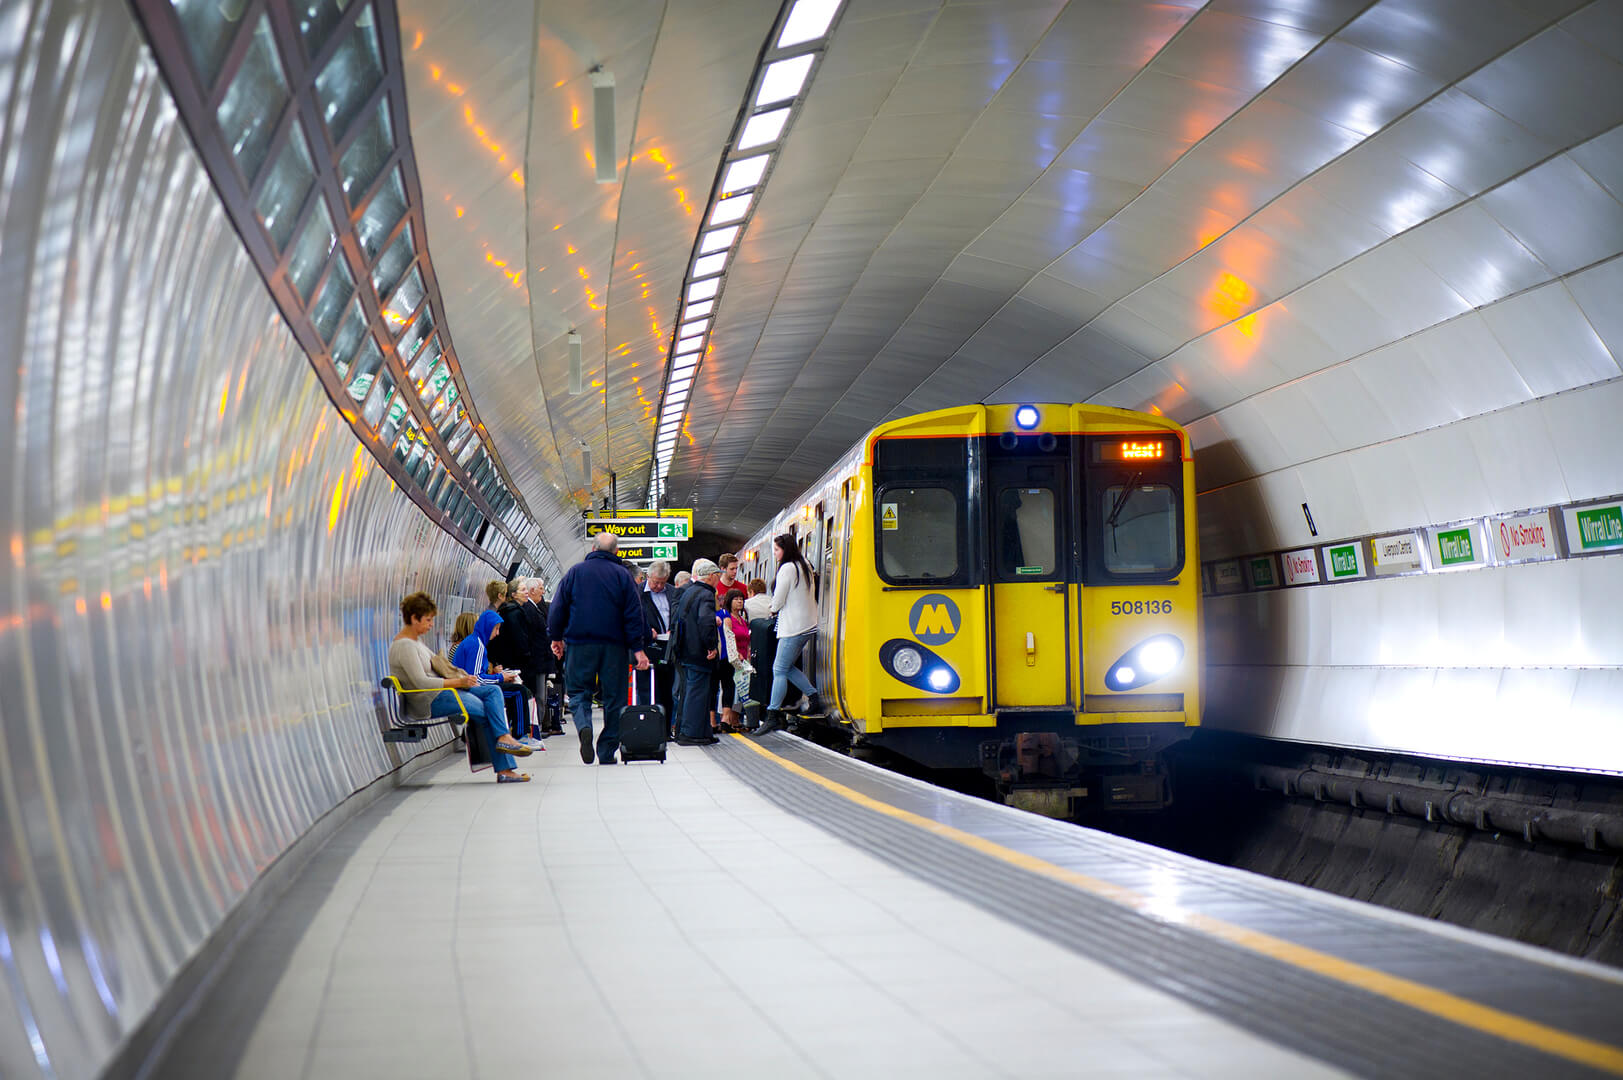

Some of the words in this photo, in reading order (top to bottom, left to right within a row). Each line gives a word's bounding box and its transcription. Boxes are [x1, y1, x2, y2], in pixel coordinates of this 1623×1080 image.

[604, 524, 626, 536] Way
[628, 525, 646, 535] out
[1509, 525, 1520, 547] No
[1519, 521, 1546, 548] Smoking
[1580, 514, 1607, 543] Wirral
[1602, 513, 1623, 541] Line
[616, 549, 628, 559] ay
[628, 548, 643, 558] out
[1440, 535, 1461, 560] Wirral
[1457, 534, 1472, 558] Line
[1292, 557, 1299, 573] No
[1297, 556, 1314, 576] Smoking
[1332, 551, 1349, 572] Wirral
[1346, 551, 1356, 571] Line
[1111, 599, 1173, 616] 508136
